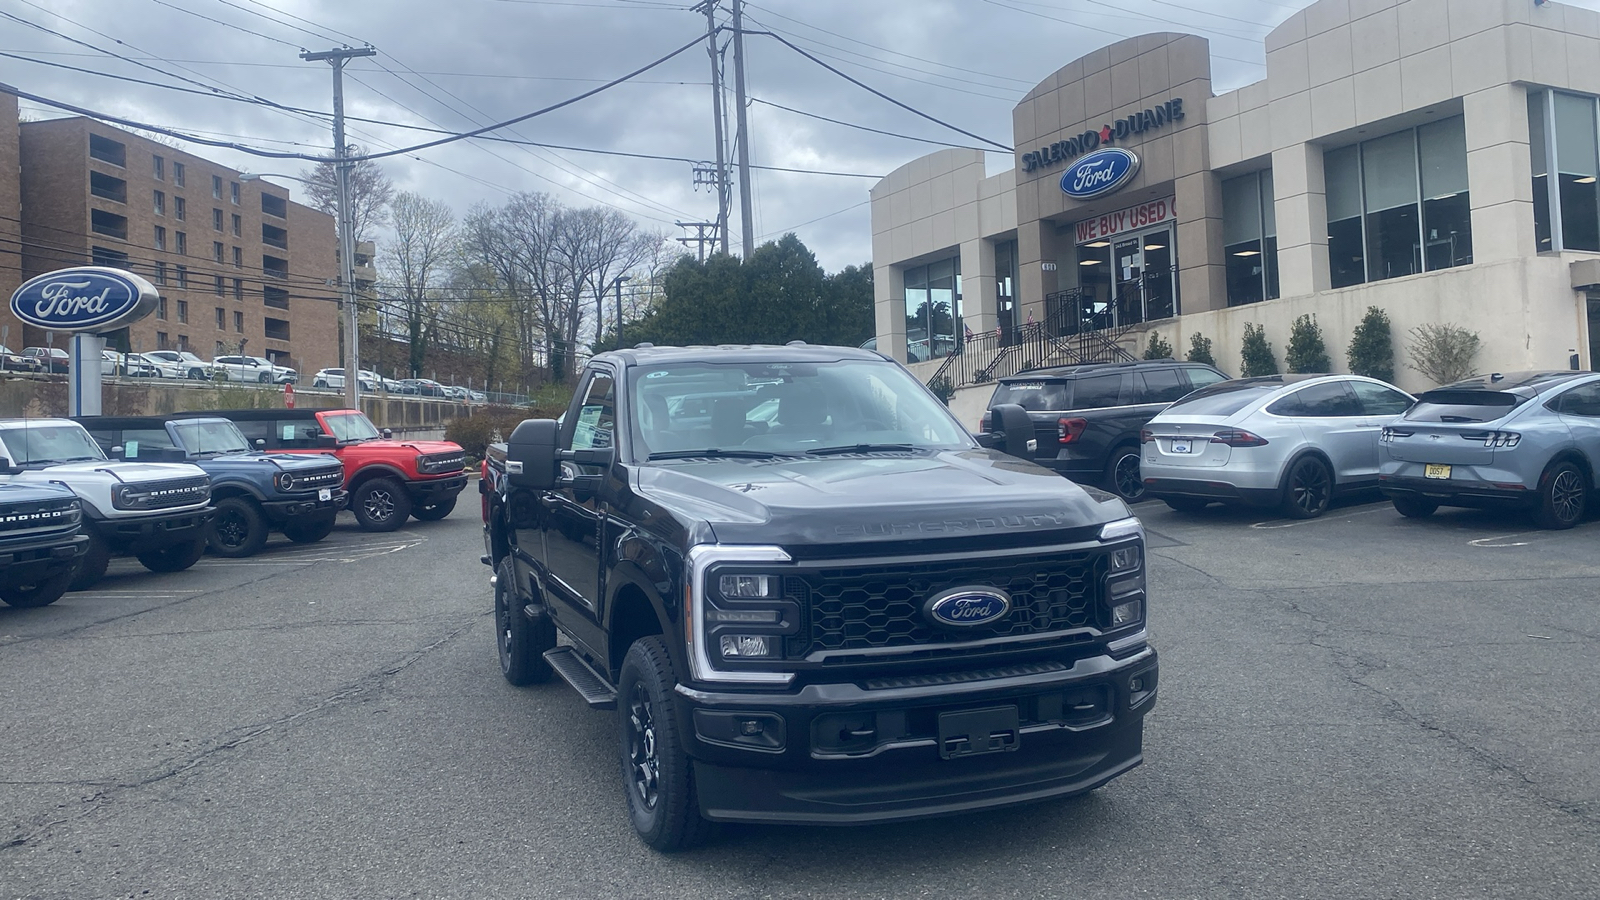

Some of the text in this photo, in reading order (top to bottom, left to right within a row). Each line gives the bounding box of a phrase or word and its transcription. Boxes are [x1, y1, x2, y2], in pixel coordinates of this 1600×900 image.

[1021, 98, 1185, 172] SALERNO DUANE
[1073, 159, 1115, 191] Ford
[1076, 219, 1097, 242] WE
[1100, 210, 1127, 236] BUY
[1129, 199, 1167, 229] USED
[35, 281, 111, 318] Ford
[150, 486, 198, 496] BRONCO
[303, 473, 337, 482] BRONCO
[835, 511, 1066, 537] SUPER DUTY
[951, 598, 993, 619] Ford
